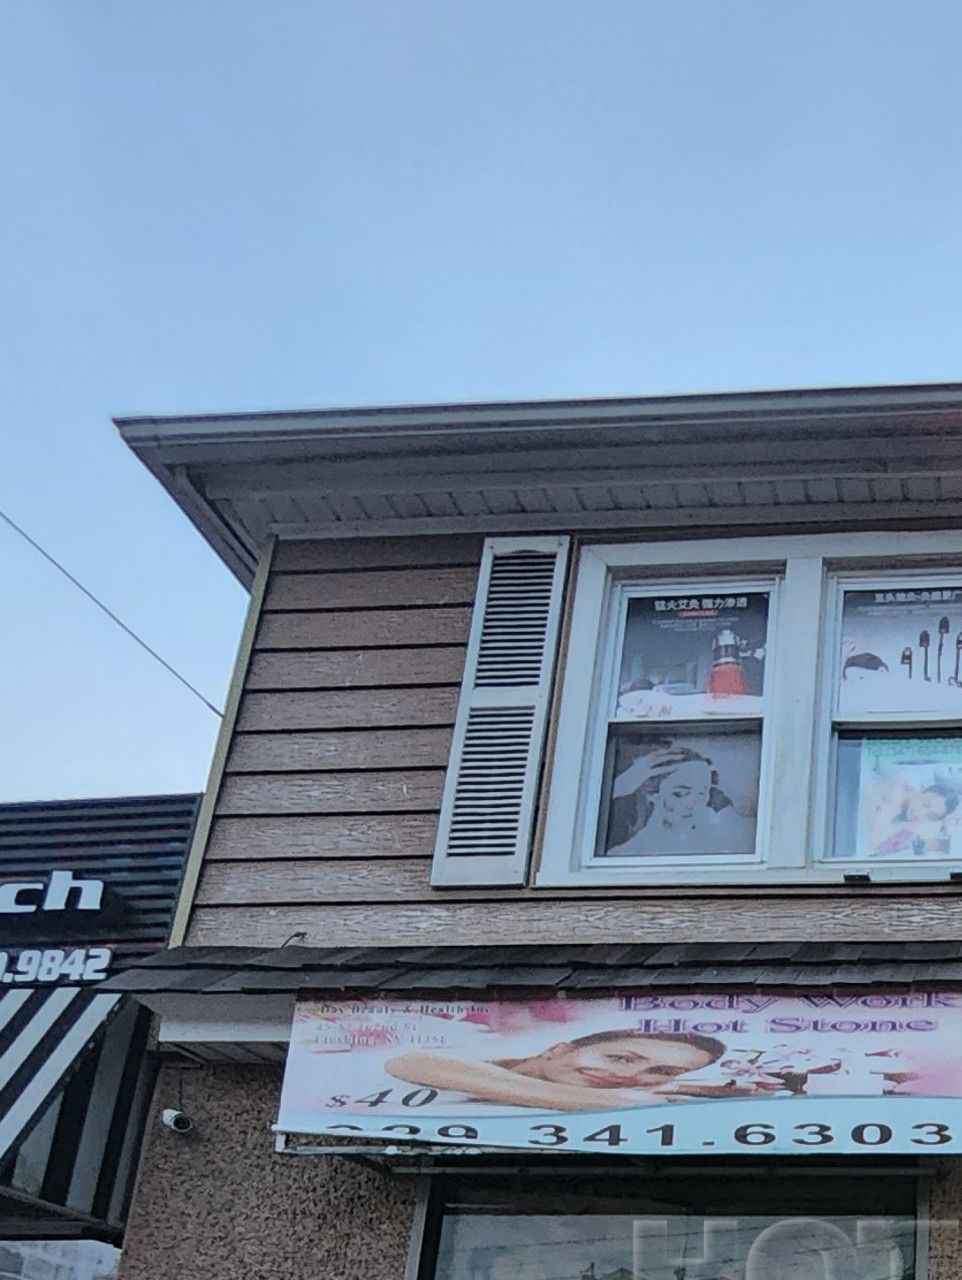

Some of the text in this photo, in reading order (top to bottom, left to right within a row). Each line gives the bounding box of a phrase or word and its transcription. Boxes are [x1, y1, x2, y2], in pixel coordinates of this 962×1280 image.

[619, 993, 962, 1013] Body Work
[635, 1017, 939, 1034] Hot Stone
